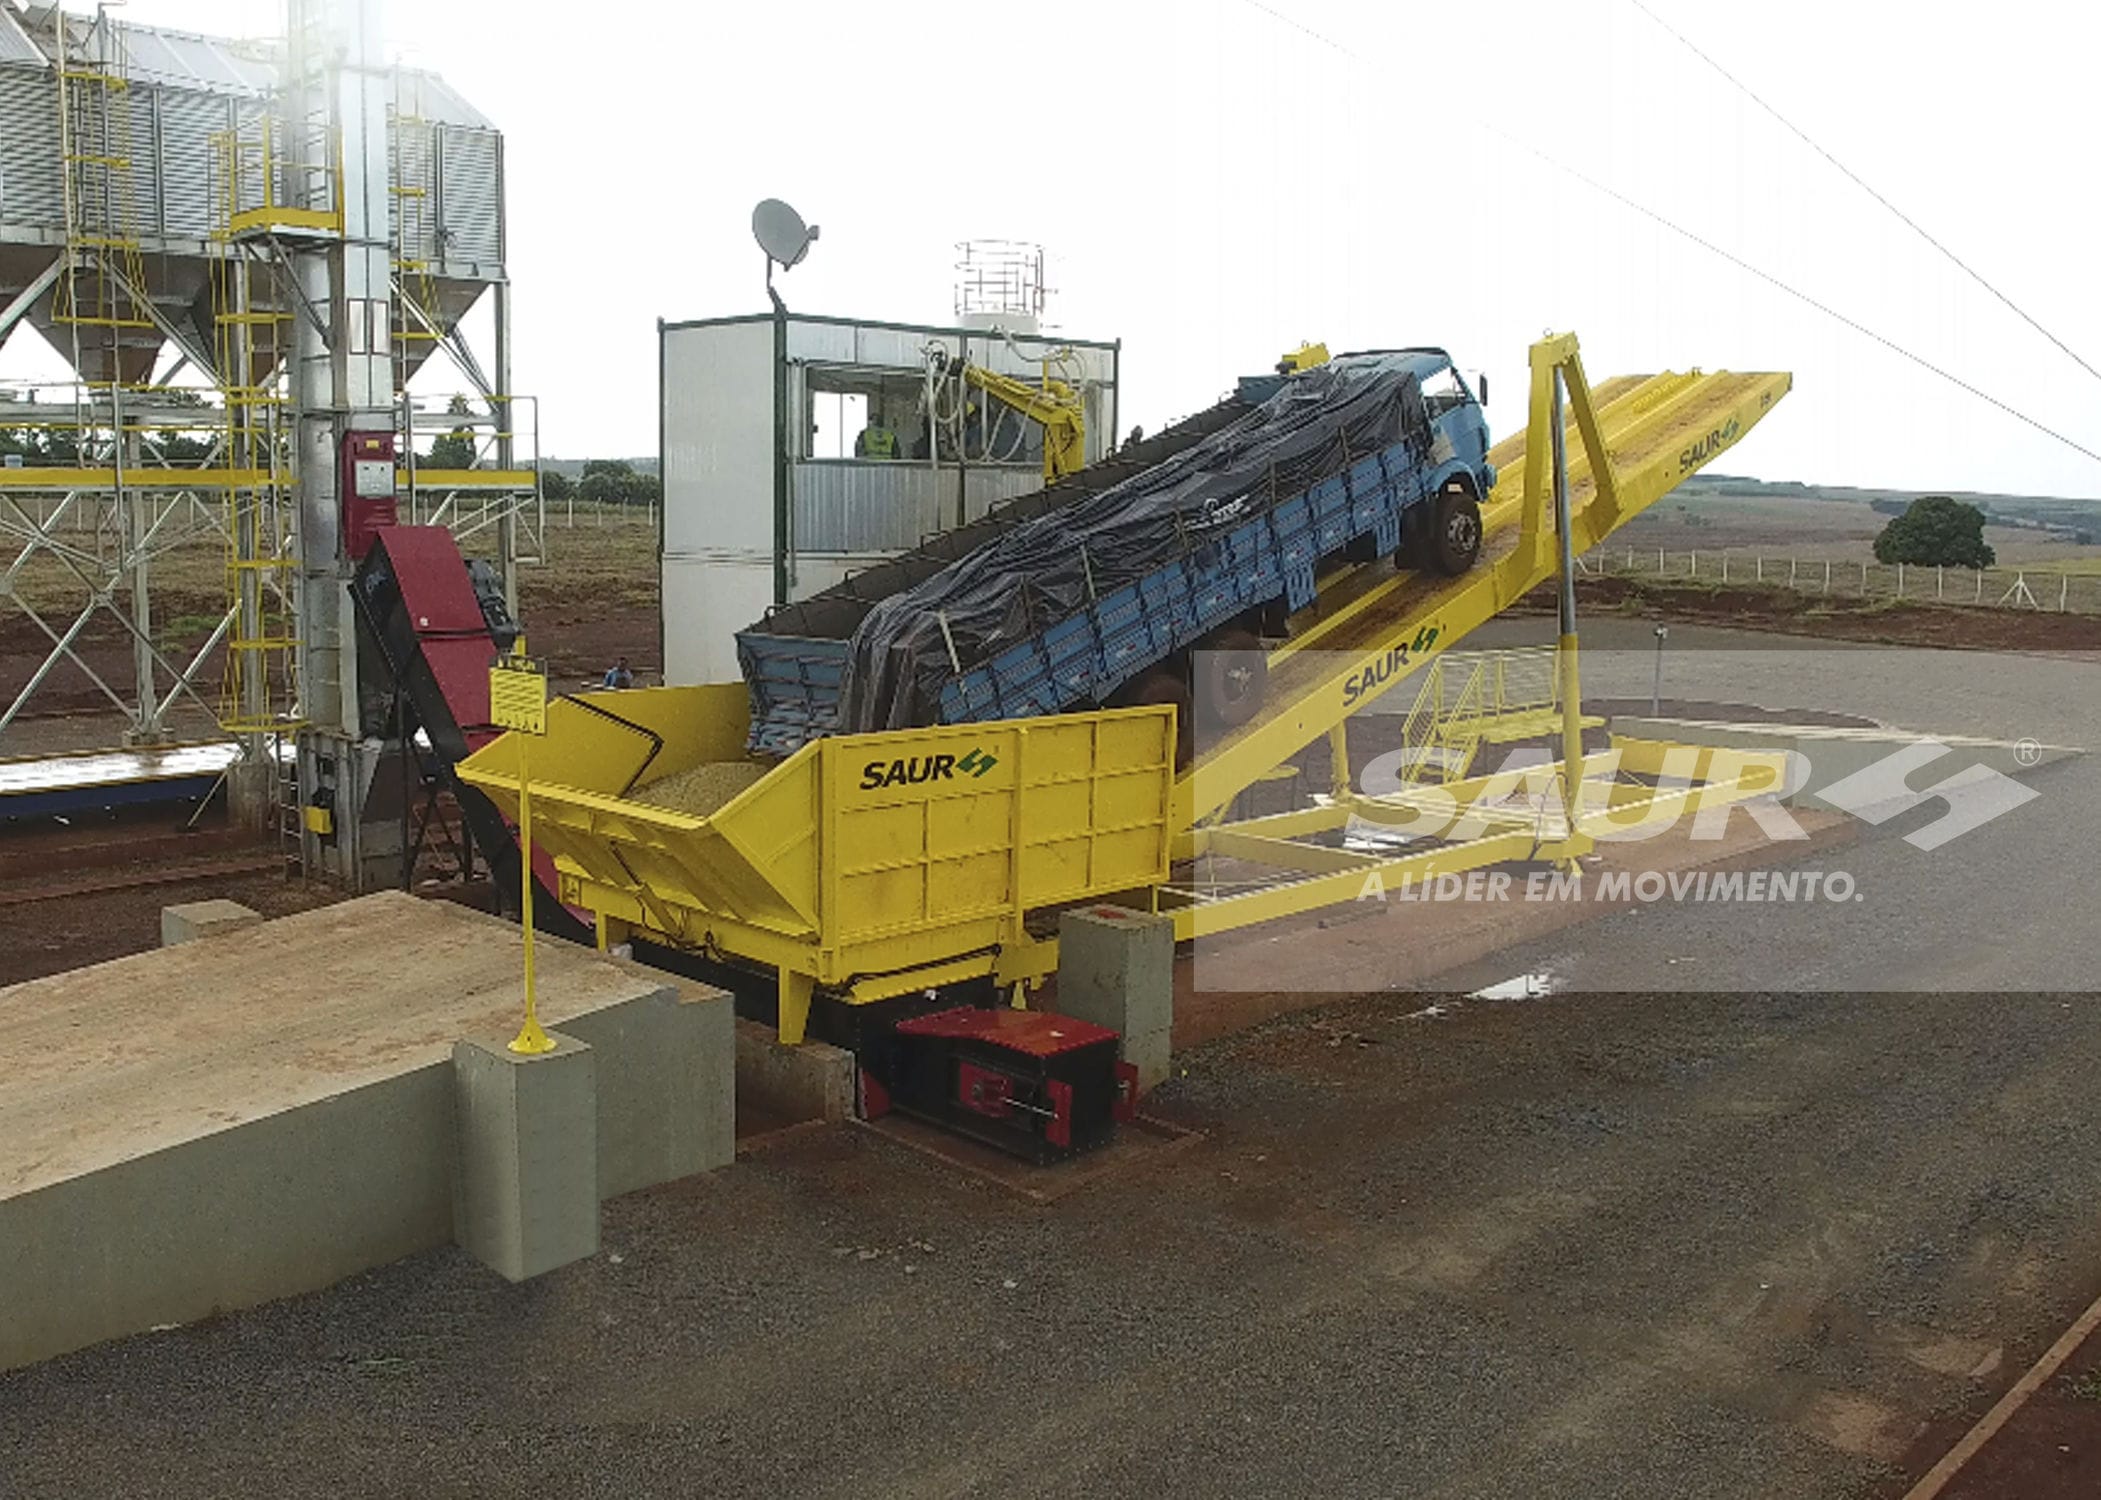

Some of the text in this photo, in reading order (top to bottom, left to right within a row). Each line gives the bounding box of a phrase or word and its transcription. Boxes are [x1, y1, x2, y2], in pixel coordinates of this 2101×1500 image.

[1679, 429, 1720, 475] SAUR
[1342, 642, 1410, 707] SAUR
[859, 754, 955, 790] SAUR
